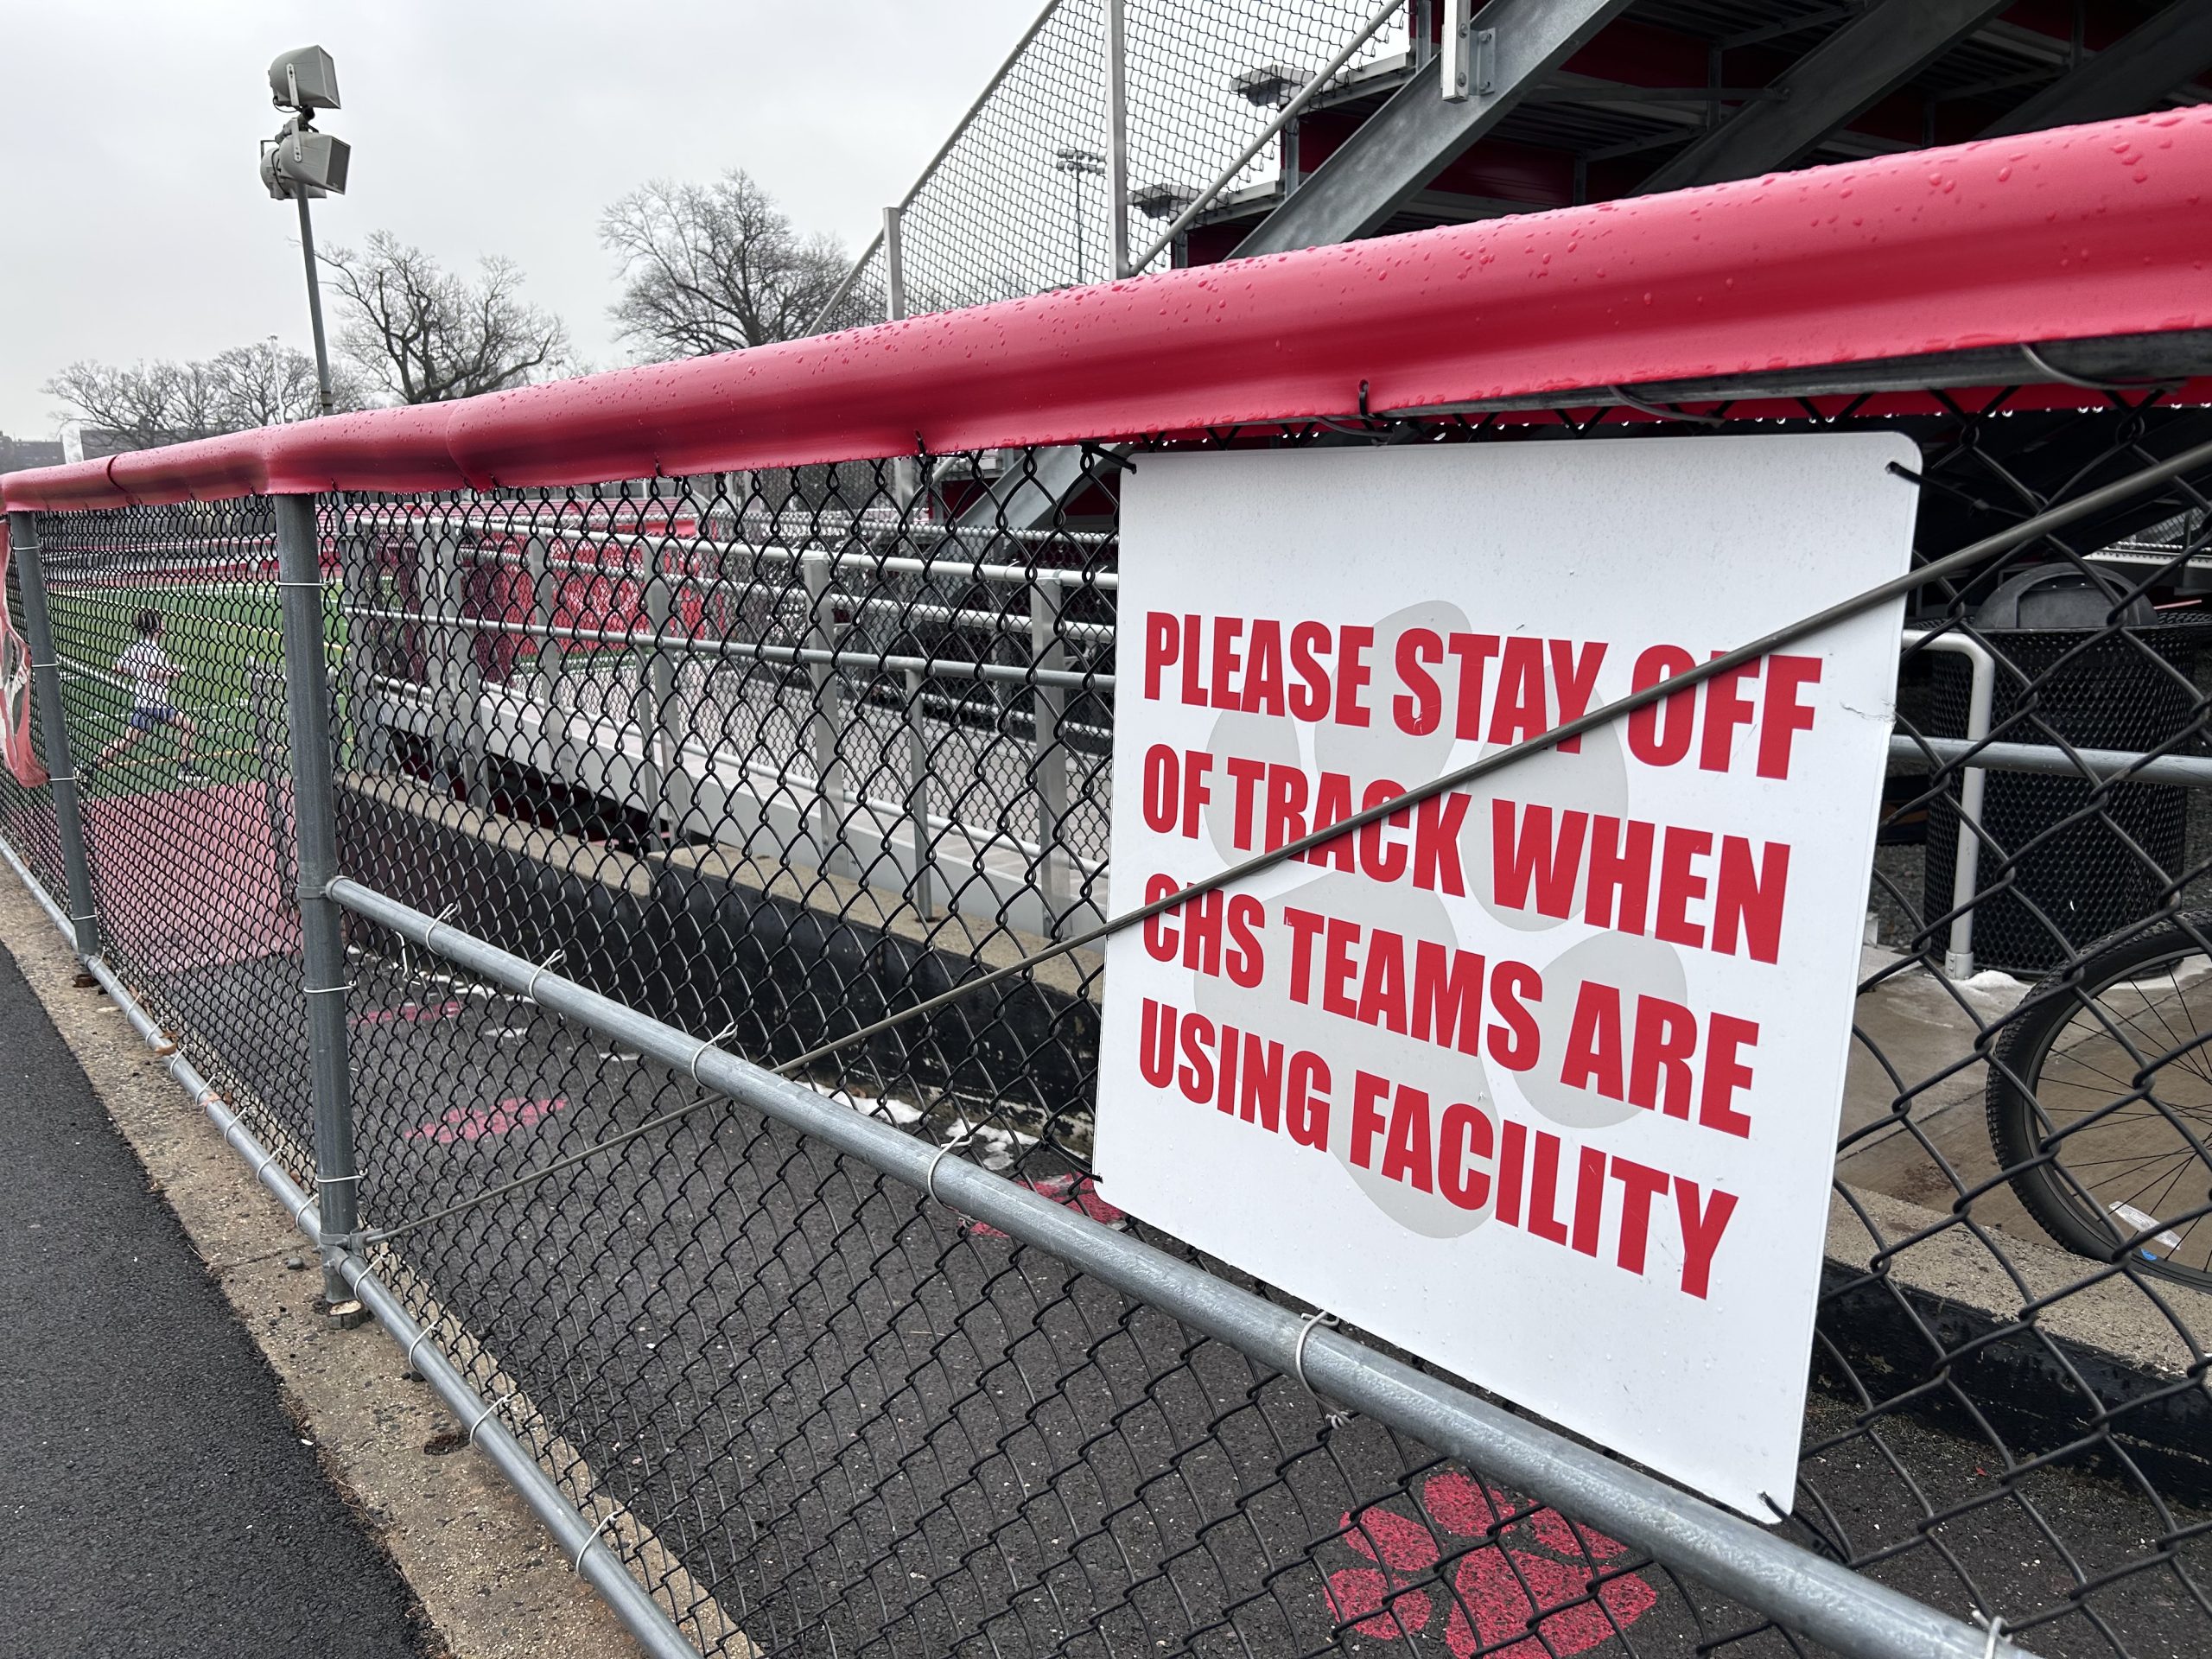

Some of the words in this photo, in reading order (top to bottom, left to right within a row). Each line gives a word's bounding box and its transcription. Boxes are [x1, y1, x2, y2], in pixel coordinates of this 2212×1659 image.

[1144, 612, 1374, 728] PLEASE
[1393, 628, 1608, 753] STAY
[1628, 645, 1822, 779] OFF
[1143, 743, 1213, 839] OF
[1227, 757, 1471, 898] TRACK
[1492, 798, 1790, 964] WHEN
[1143, 874, 1265, 988] CHS
[1283, 906, 1543, 1071] TEAMS
[1560, 981, 1759, 1138] ARE
[1140, 997, 1332, 1153] USING
[1350, 1070, 1738, 1300] FACILITY
